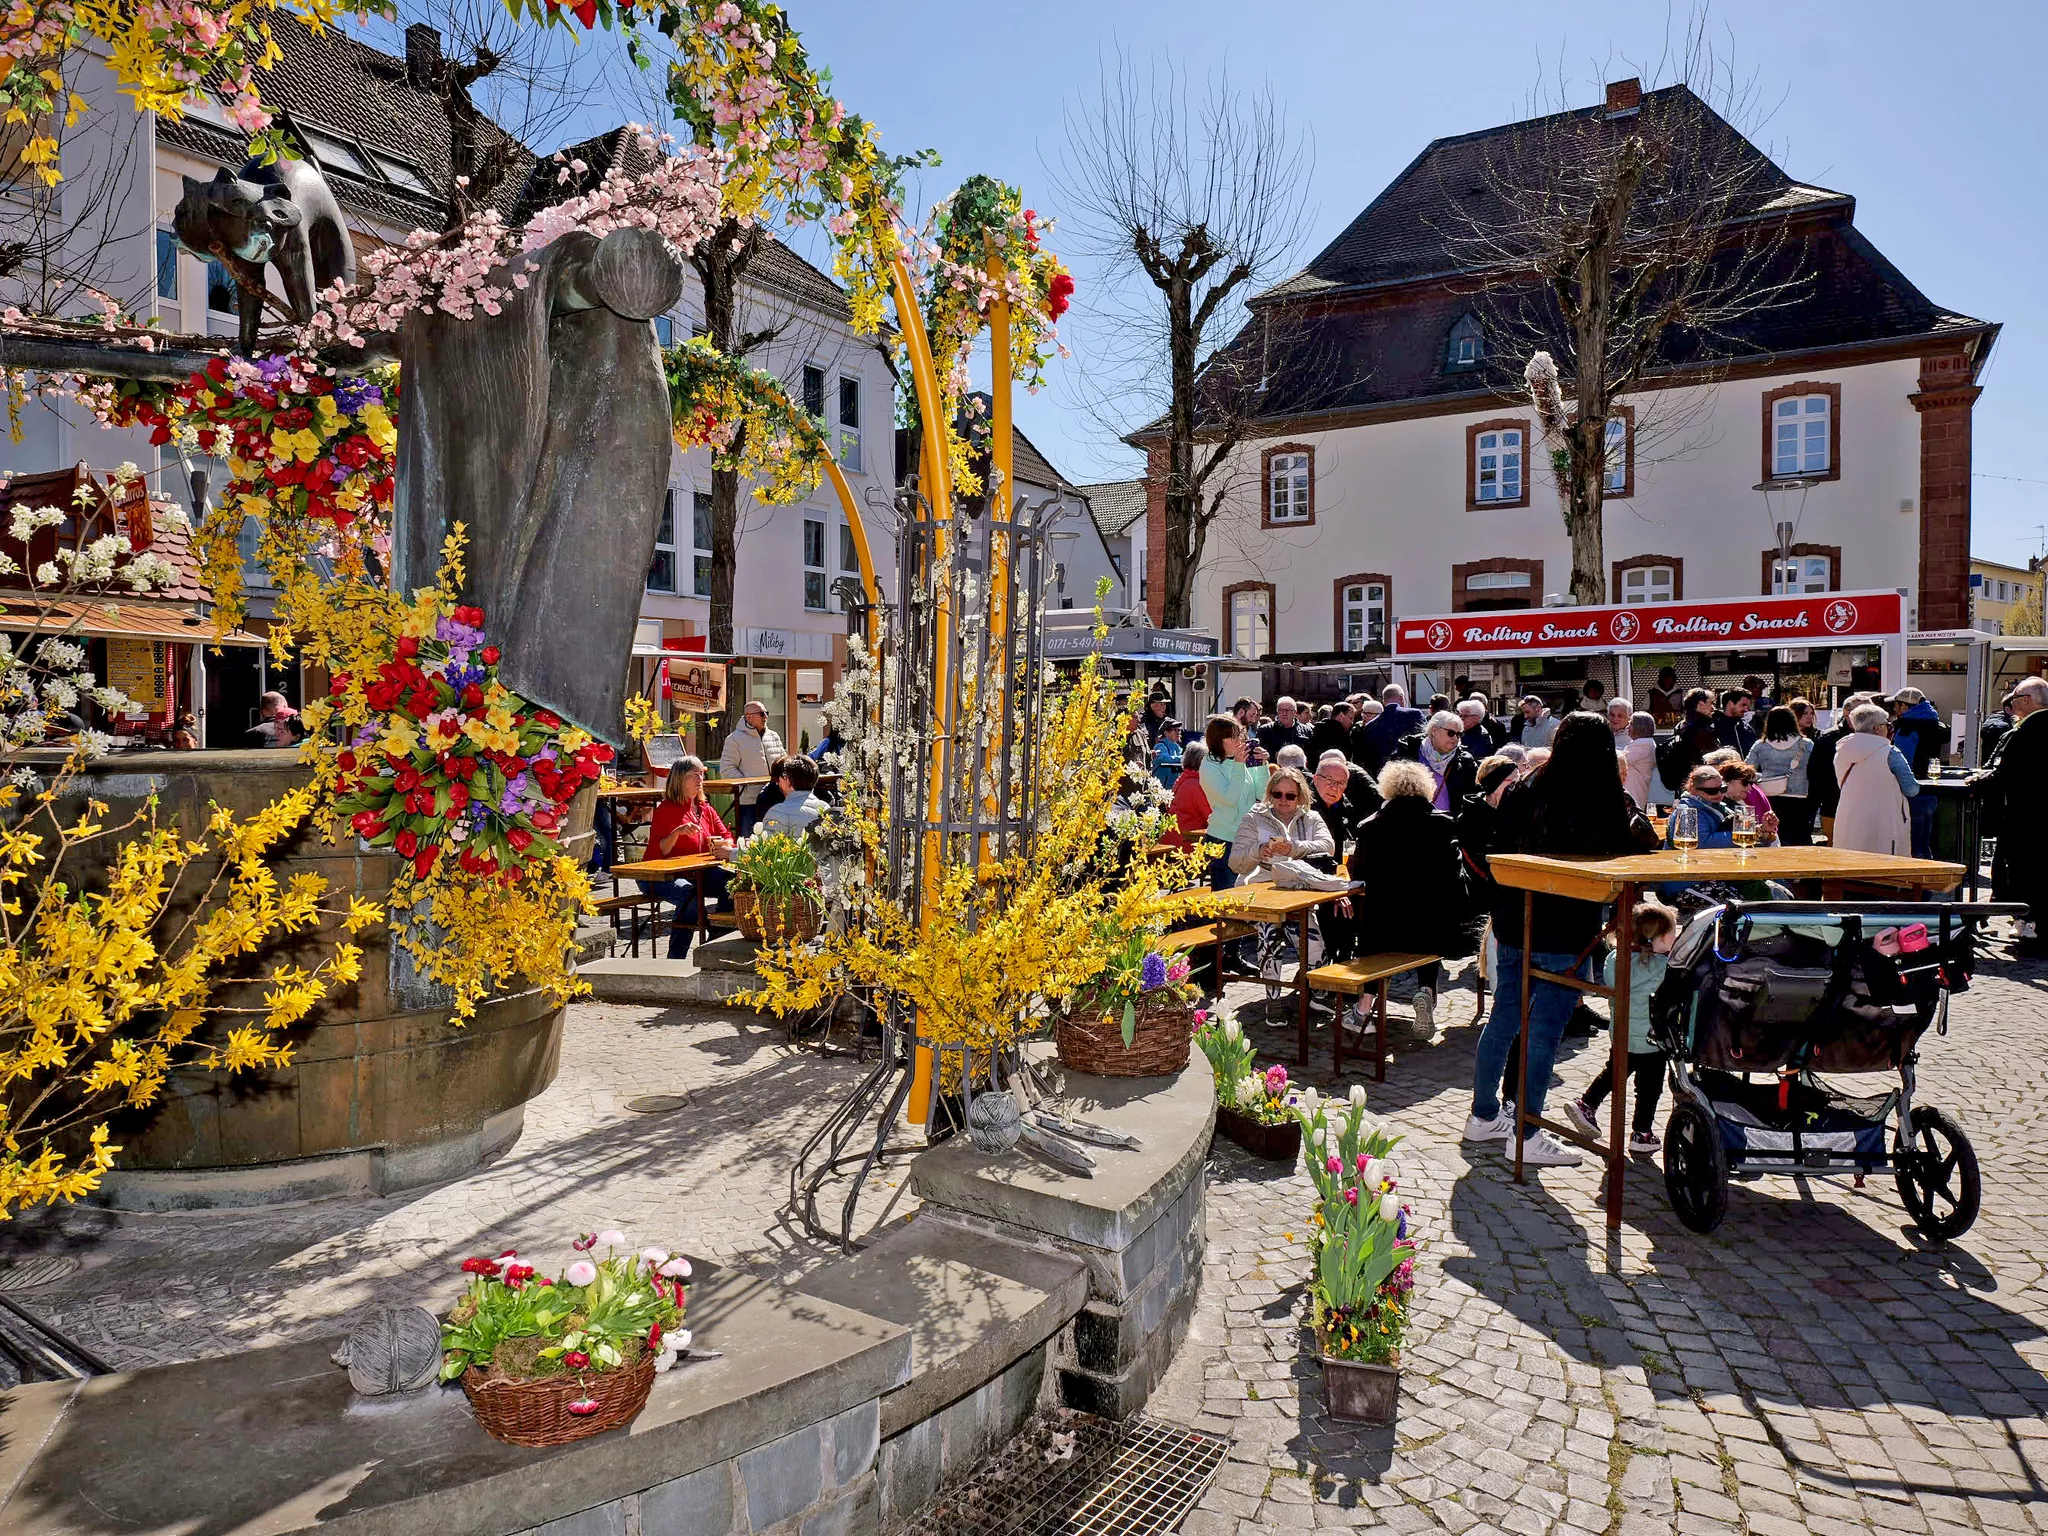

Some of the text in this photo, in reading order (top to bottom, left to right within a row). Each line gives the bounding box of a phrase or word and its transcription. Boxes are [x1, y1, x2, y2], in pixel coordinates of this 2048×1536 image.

[1463, 621, 1598, 644] Rolling Snack
[1653, 610, 1809, 635] Rolling Snack
[1152, 636, 1170, 650] EVENT
[1175, 640, 1192, 651] PARTY
[1192, 642, 1212, 654] SERVICE
[278, 681, 288, 694] 2
